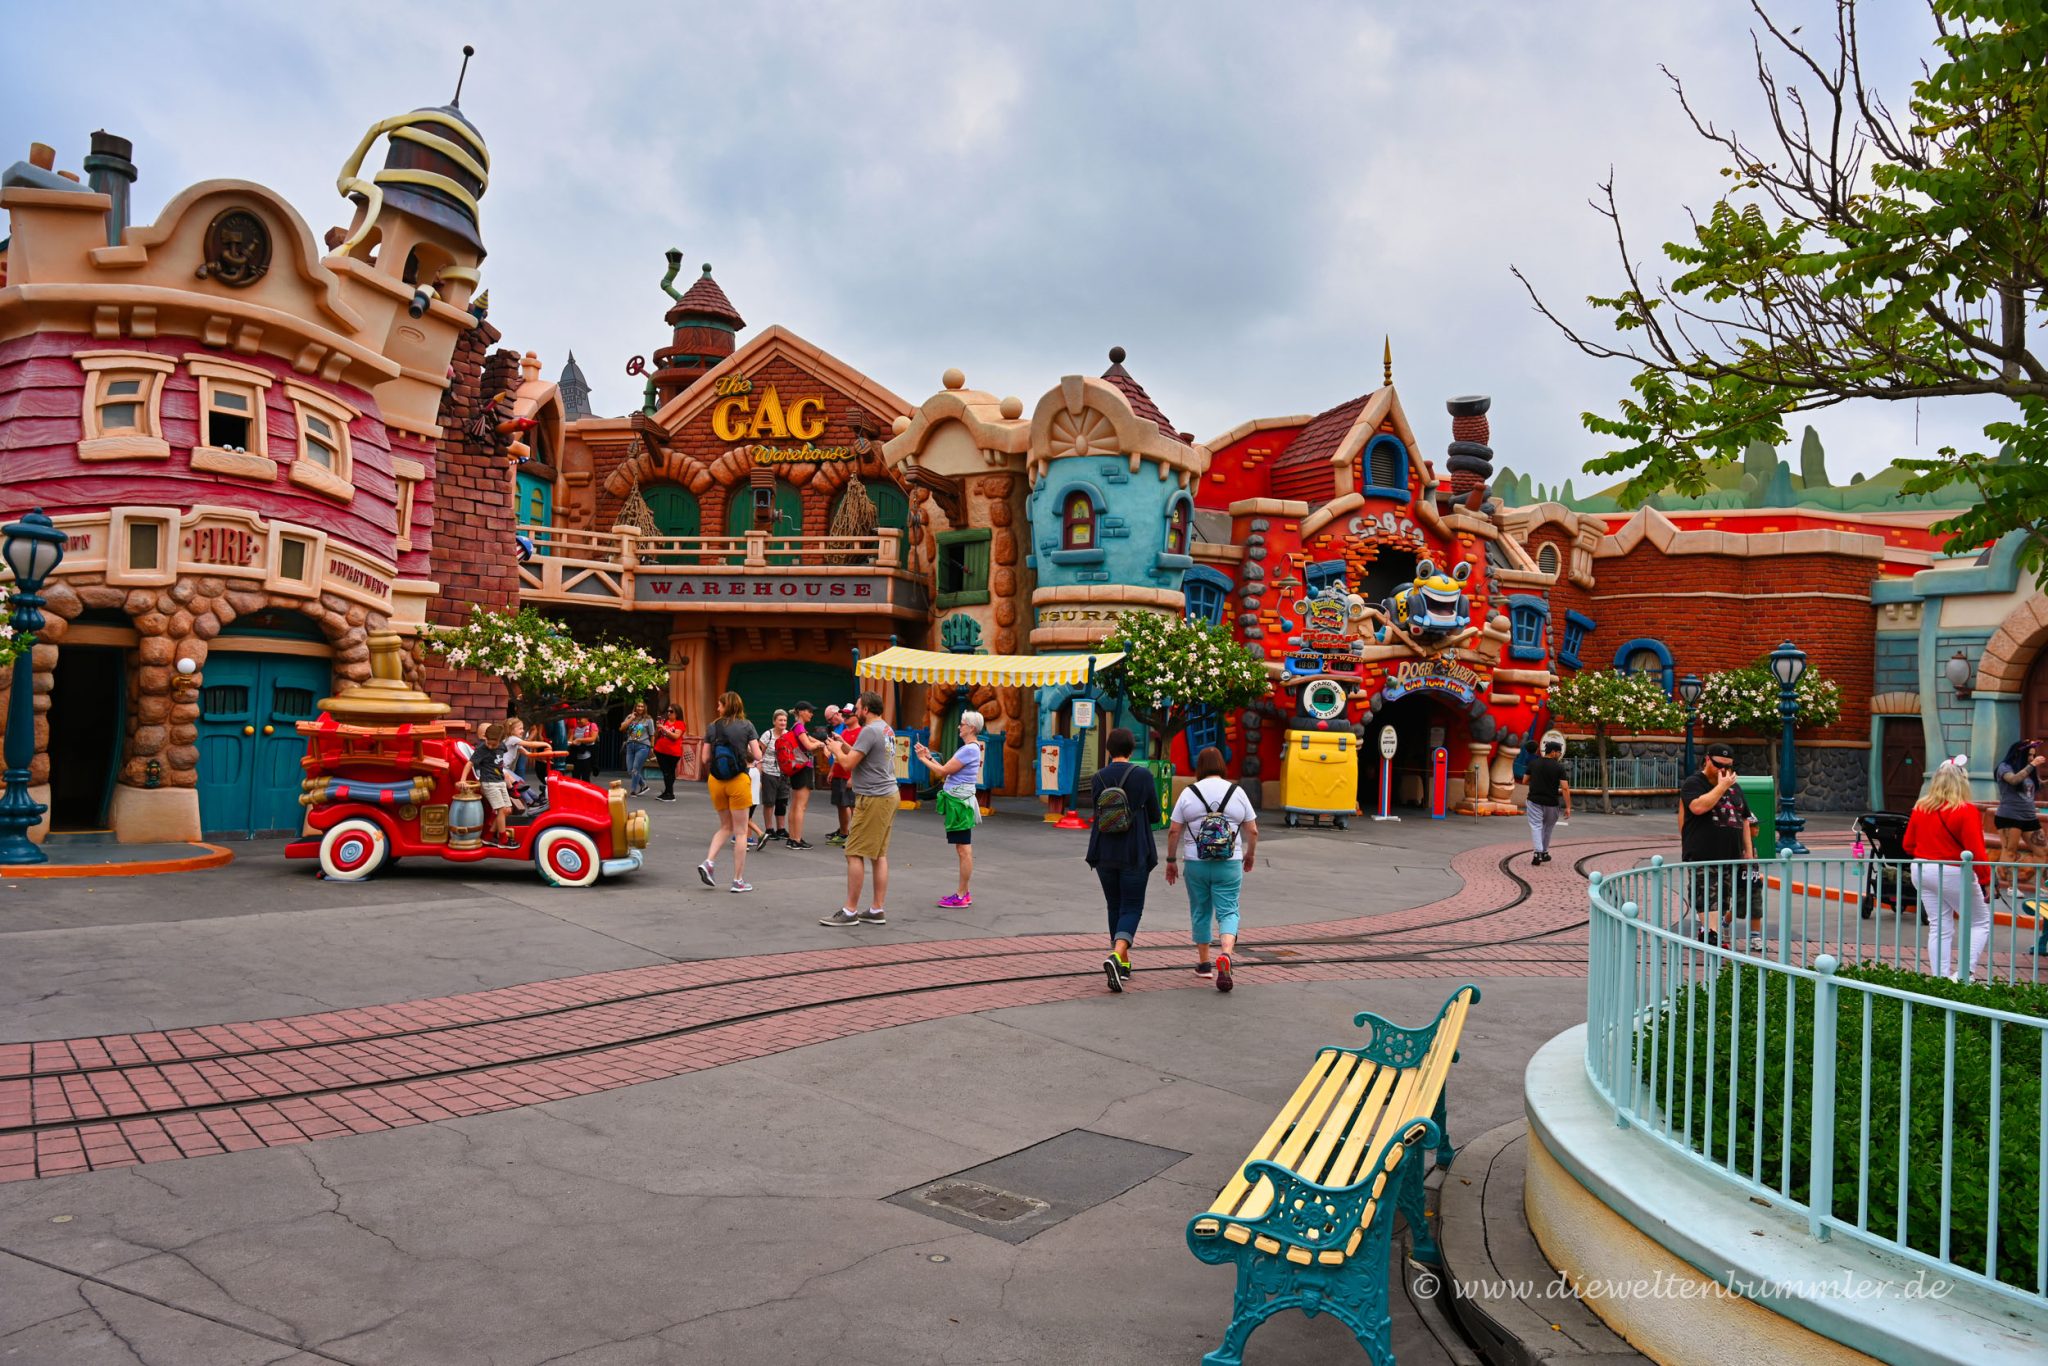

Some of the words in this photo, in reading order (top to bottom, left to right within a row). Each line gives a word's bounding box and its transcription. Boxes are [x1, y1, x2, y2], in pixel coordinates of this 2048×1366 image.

[715, 373, 752, 396] The
[712, 383, 829, 442] GAG
[751, 442, 856, 464] Warehouse
[193, 528, 253, 565] FIRE
[329, 559, 390, 598] DEPARTMENT
[650, 581, 872, 597] WAREHOUSE
[1282, 651, 1319, 659] RETURN
[1322, 653, 1364, 663] BETWEEN
[1396, 661, 1434, 689] ROGER
